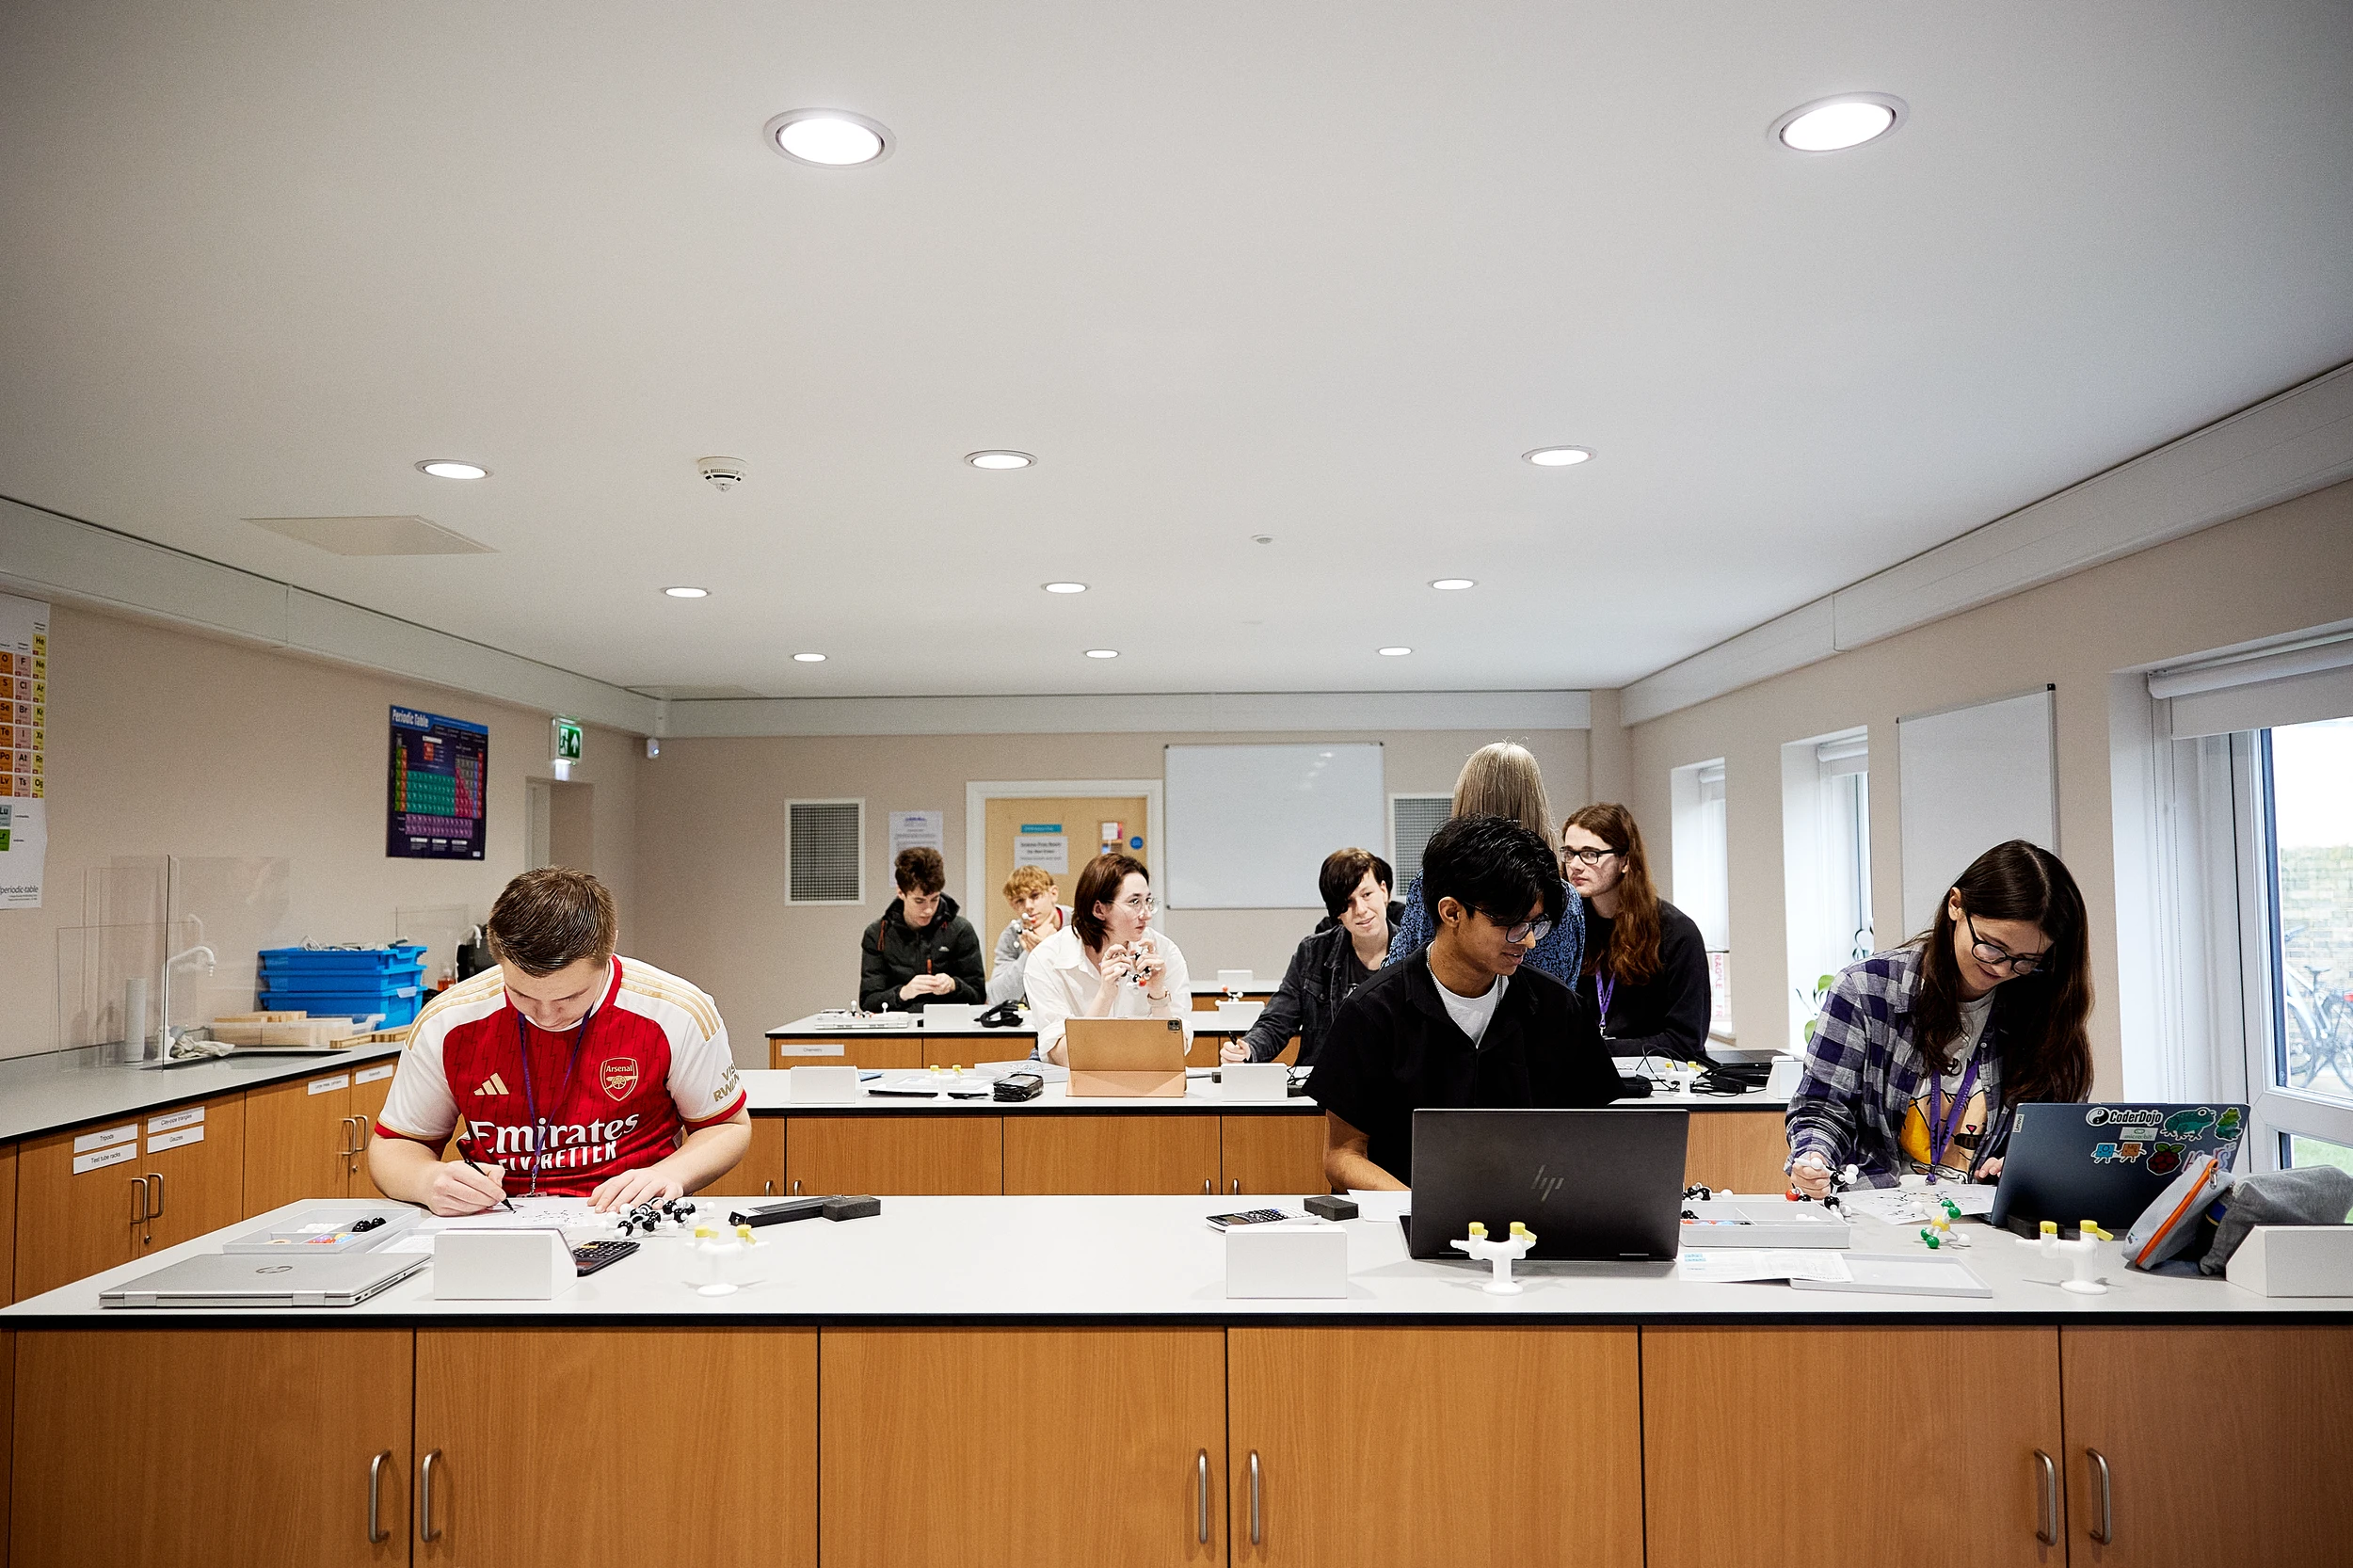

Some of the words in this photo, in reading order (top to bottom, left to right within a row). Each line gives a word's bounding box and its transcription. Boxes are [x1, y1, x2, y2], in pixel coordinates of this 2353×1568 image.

[36, 636, 44, 645] He
[1, 703, 9, 712] Se
[392, 709, 414, 725] Periodic
[415, 713, 429, 728] Table
[19, 777, 26, 786] Ts
[1714, 954, 1723, 989] RAGILE
[605, 1064, 632, 1073] Arsenal
[722, 1064, 735, 1080] VIS
[2110, 1111, 2162, 1127] CoderDojo
[470, 1113, 639, 1154] Emirates
